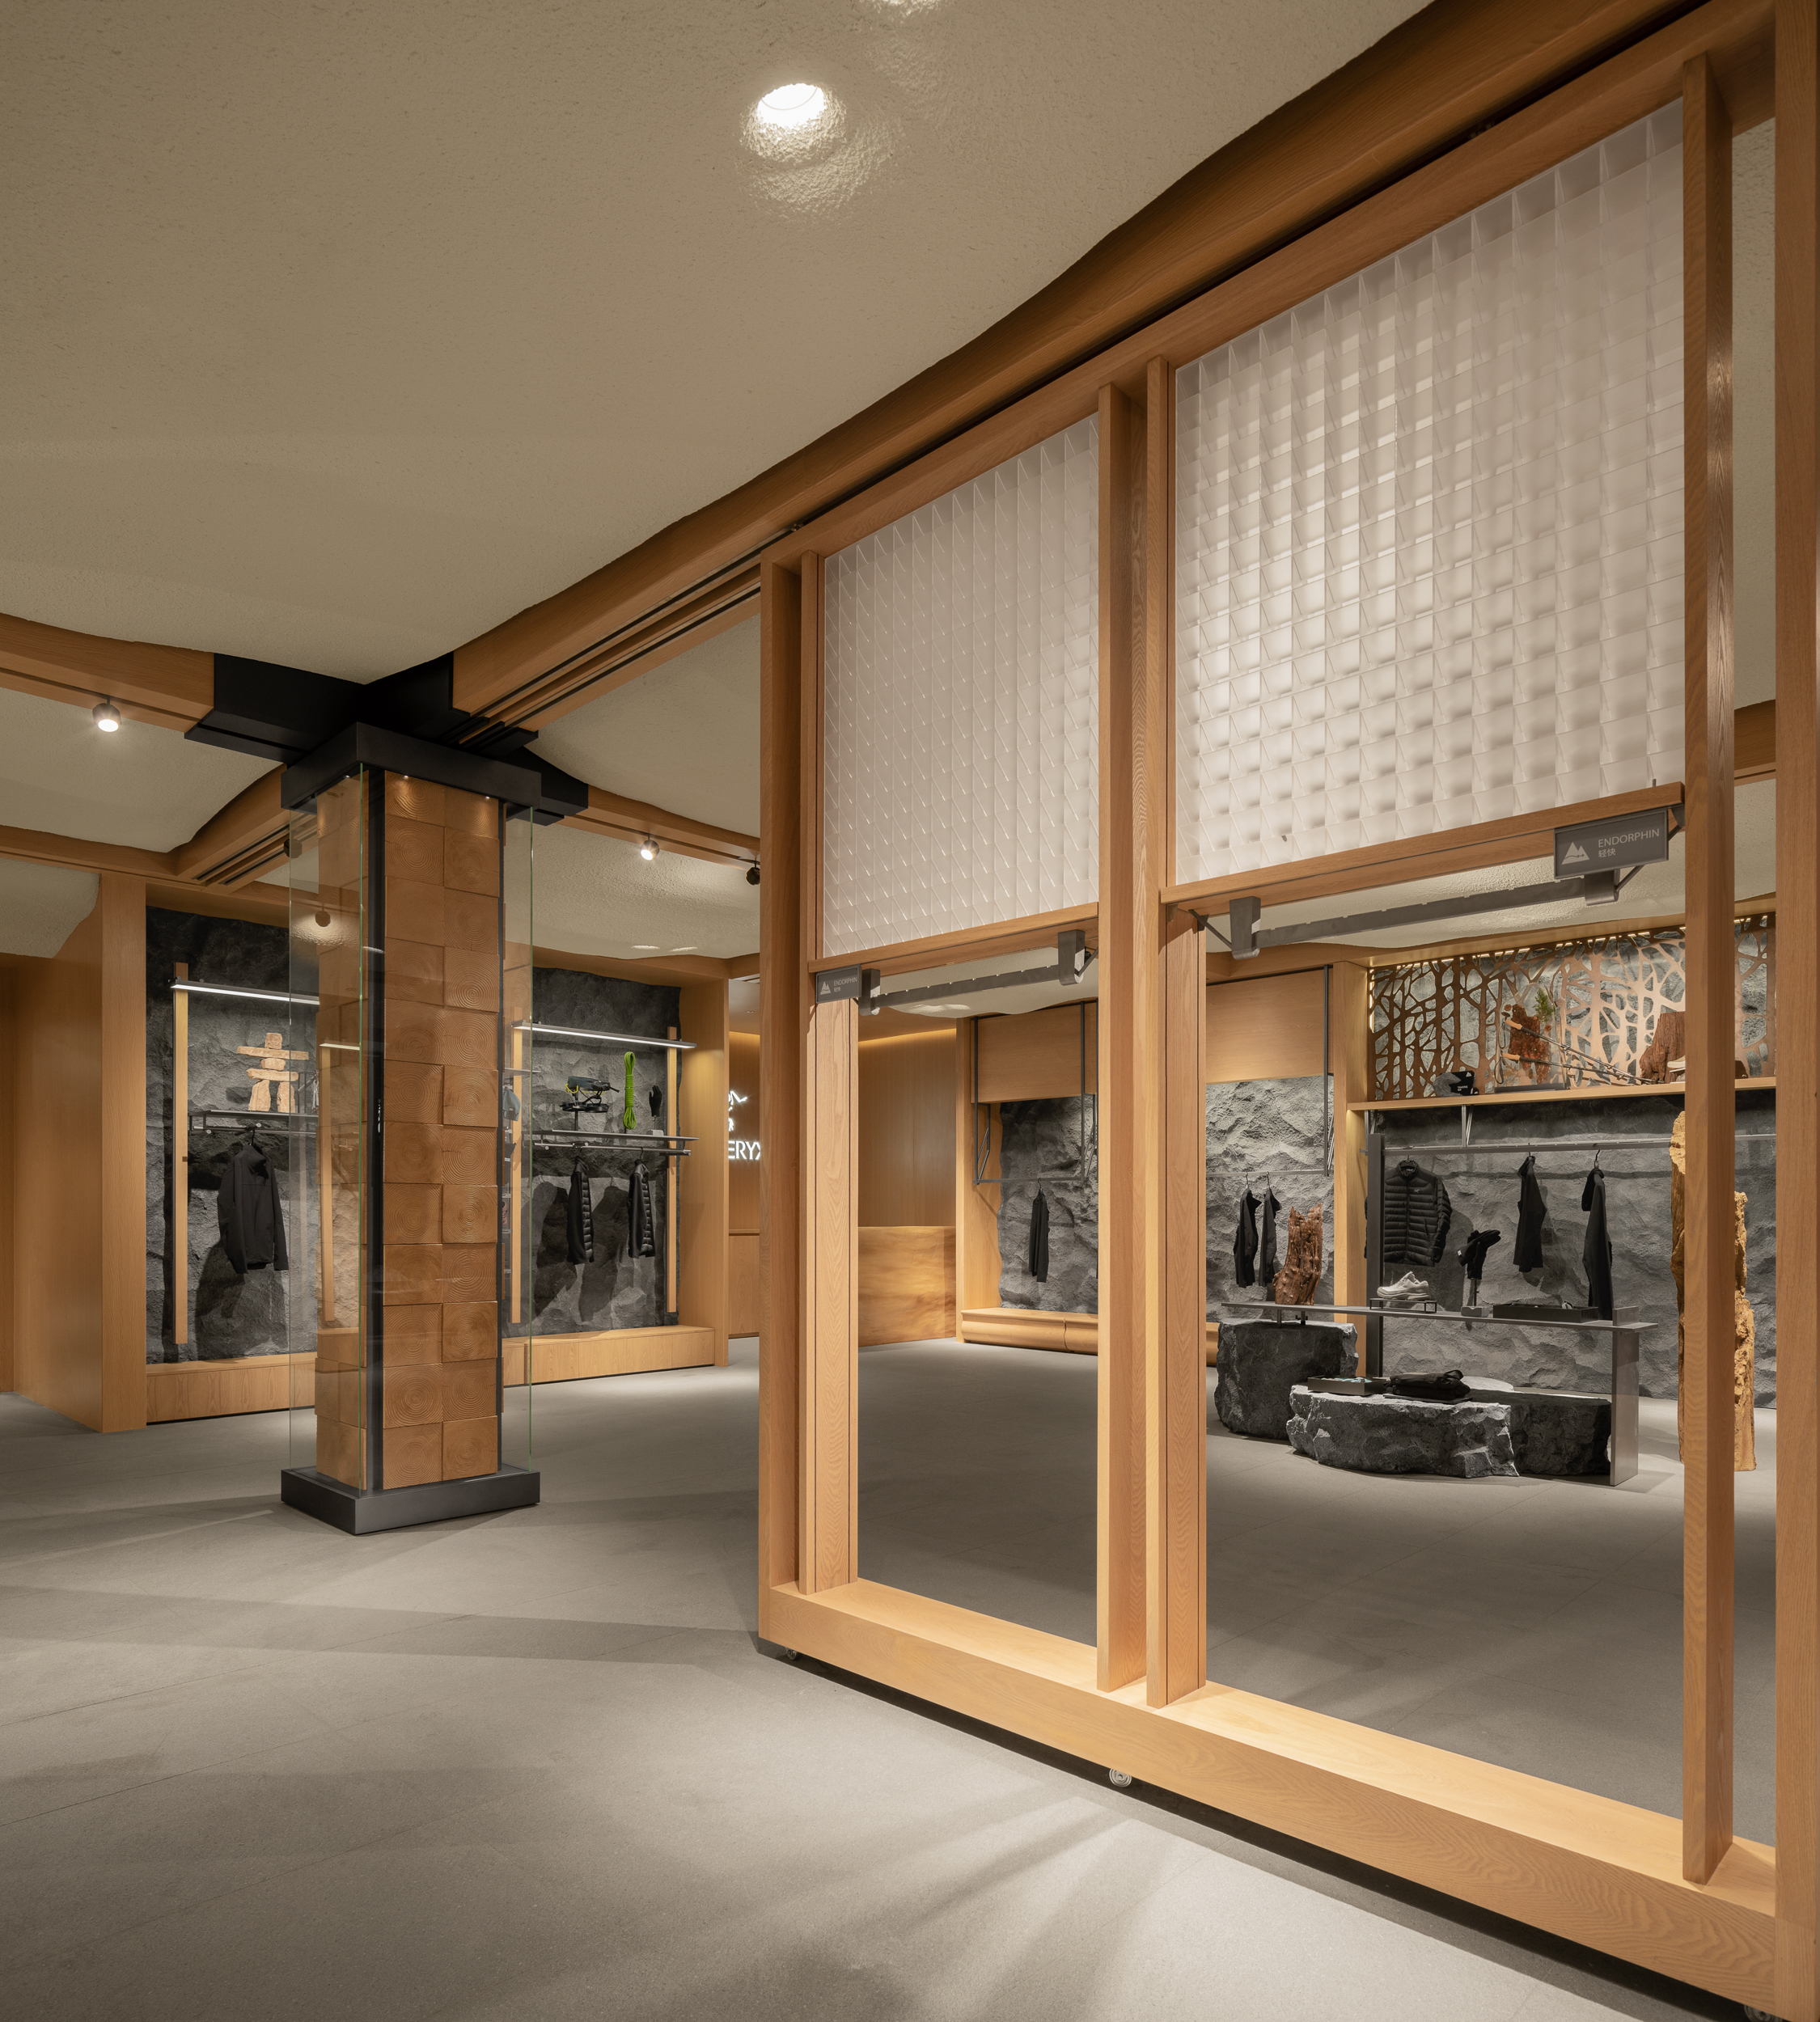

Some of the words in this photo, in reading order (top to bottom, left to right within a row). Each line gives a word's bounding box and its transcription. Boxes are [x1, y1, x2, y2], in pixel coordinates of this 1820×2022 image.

[1598, 828, 1660, 848] ENDORPHIN
[1598, 848, 1616, 858] 轻快
[833, 976, 857, 987] ENDORPHIN
